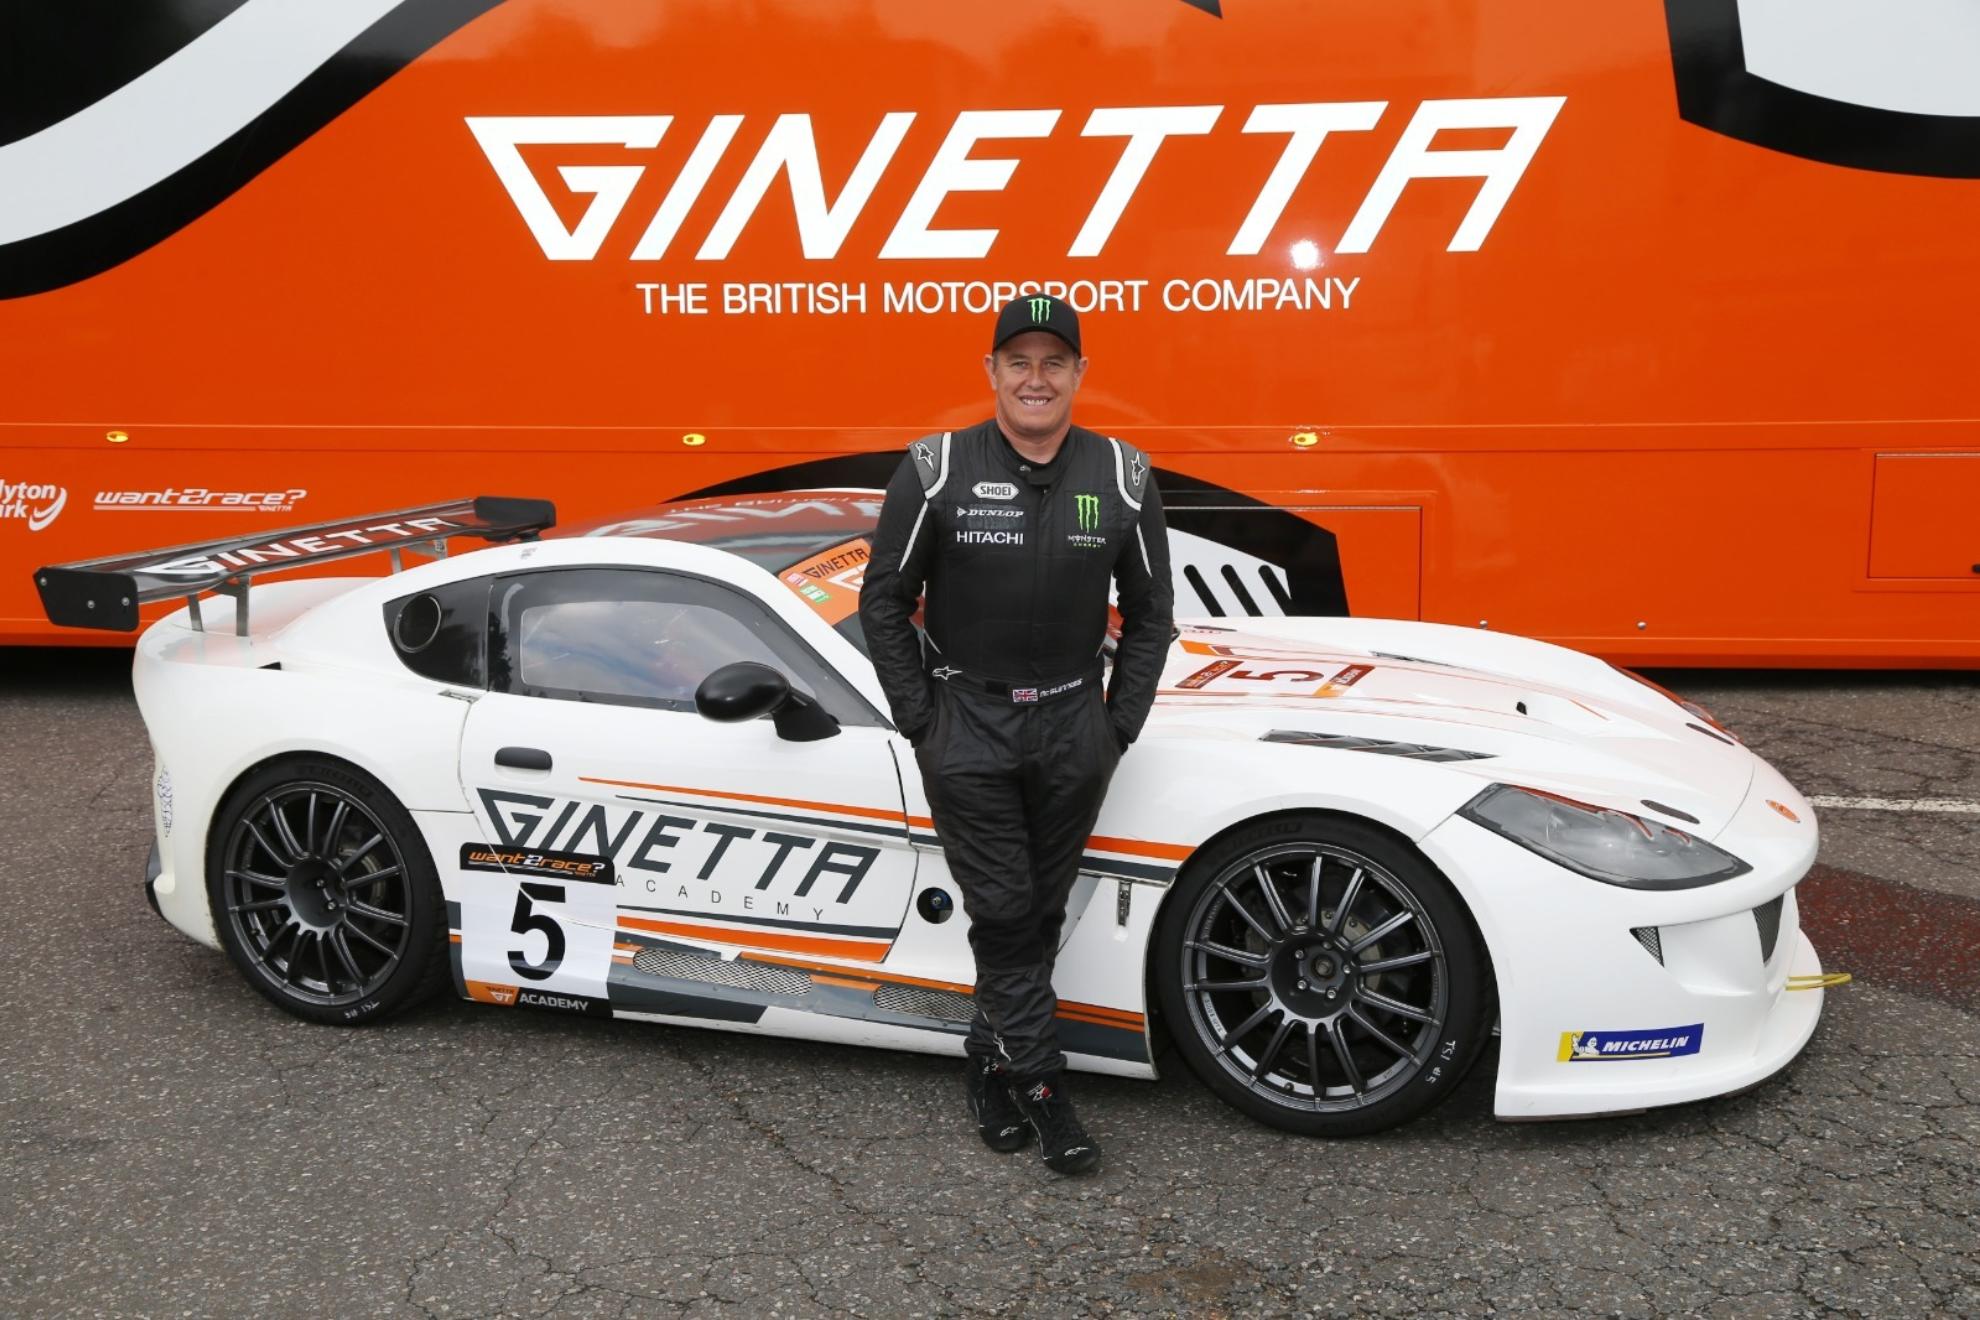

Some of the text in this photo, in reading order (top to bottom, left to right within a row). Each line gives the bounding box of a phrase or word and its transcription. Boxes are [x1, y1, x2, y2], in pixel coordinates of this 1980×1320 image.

[463, 96, 1567, 260] GINETTA
[636, 283, 708, 314] THE
[723, 282, 867, 314] BRITISH
[1162, 276, 1361, 311] COMPANY
[94, 488, 307, 504] want2race?
[980, 485, 1012, 496] SHOEI
[967, 508, 1025, 518] DUNLOP
[133, 517, 462, 575] GINETTA
[956, 531, 1025, 545] HITACHI
[1068, 534, 1107, 545] MONSTER
[801, 548, 870, 579] GINETTA
[476, 788, 882, 905] GINETTA
[468, 851, 606, 873] want2race?
[615, 873, 824, 921] ACADEMY
[507, 882, 566, 981] 5
[519, 993, 589, 1011] ACADEMY
[1602, 1034, 1690, 1053] MICHELIN
